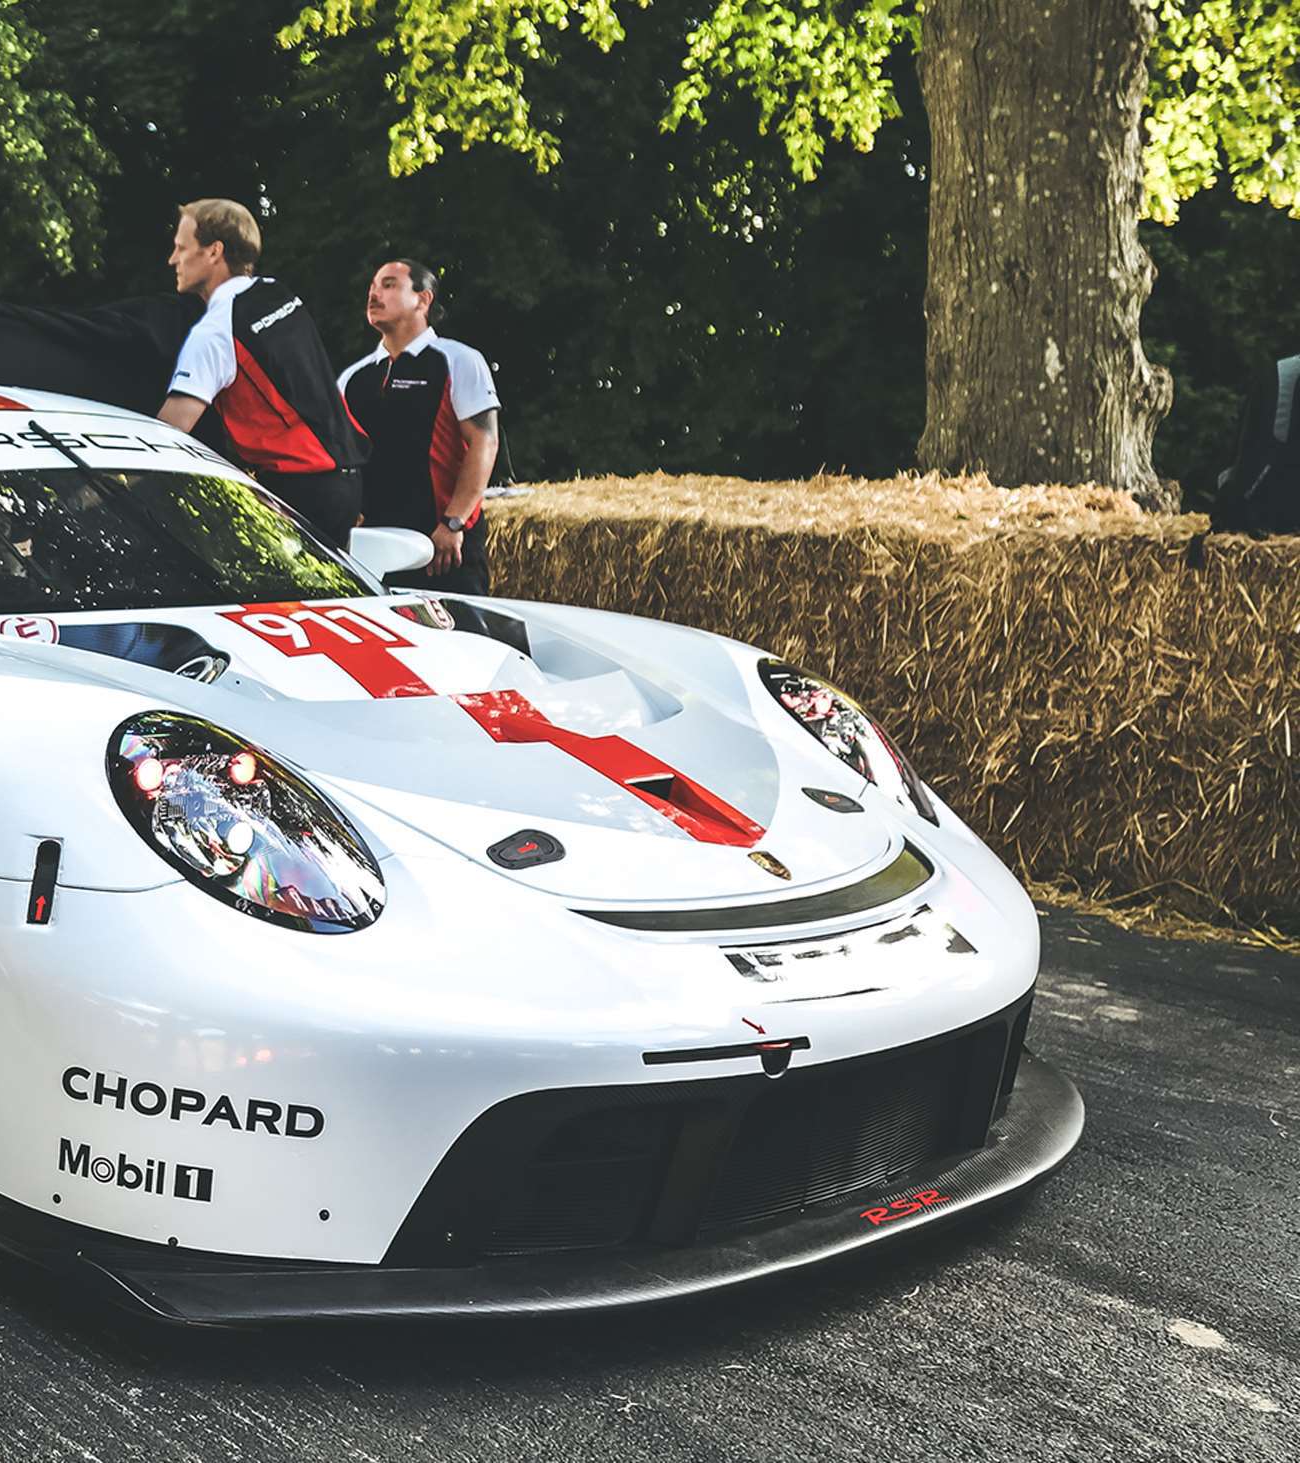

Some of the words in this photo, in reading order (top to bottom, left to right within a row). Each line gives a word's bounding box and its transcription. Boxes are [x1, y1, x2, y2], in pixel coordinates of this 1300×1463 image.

[251, 296, 303, 334] PORSCH
[242, 607, 400, 648] 911
[62, 1066, 325, 1139] CHOPARD
[58, 1137, 166, 1195] Mobil
[860, 1189, 951, 1226] RSR
